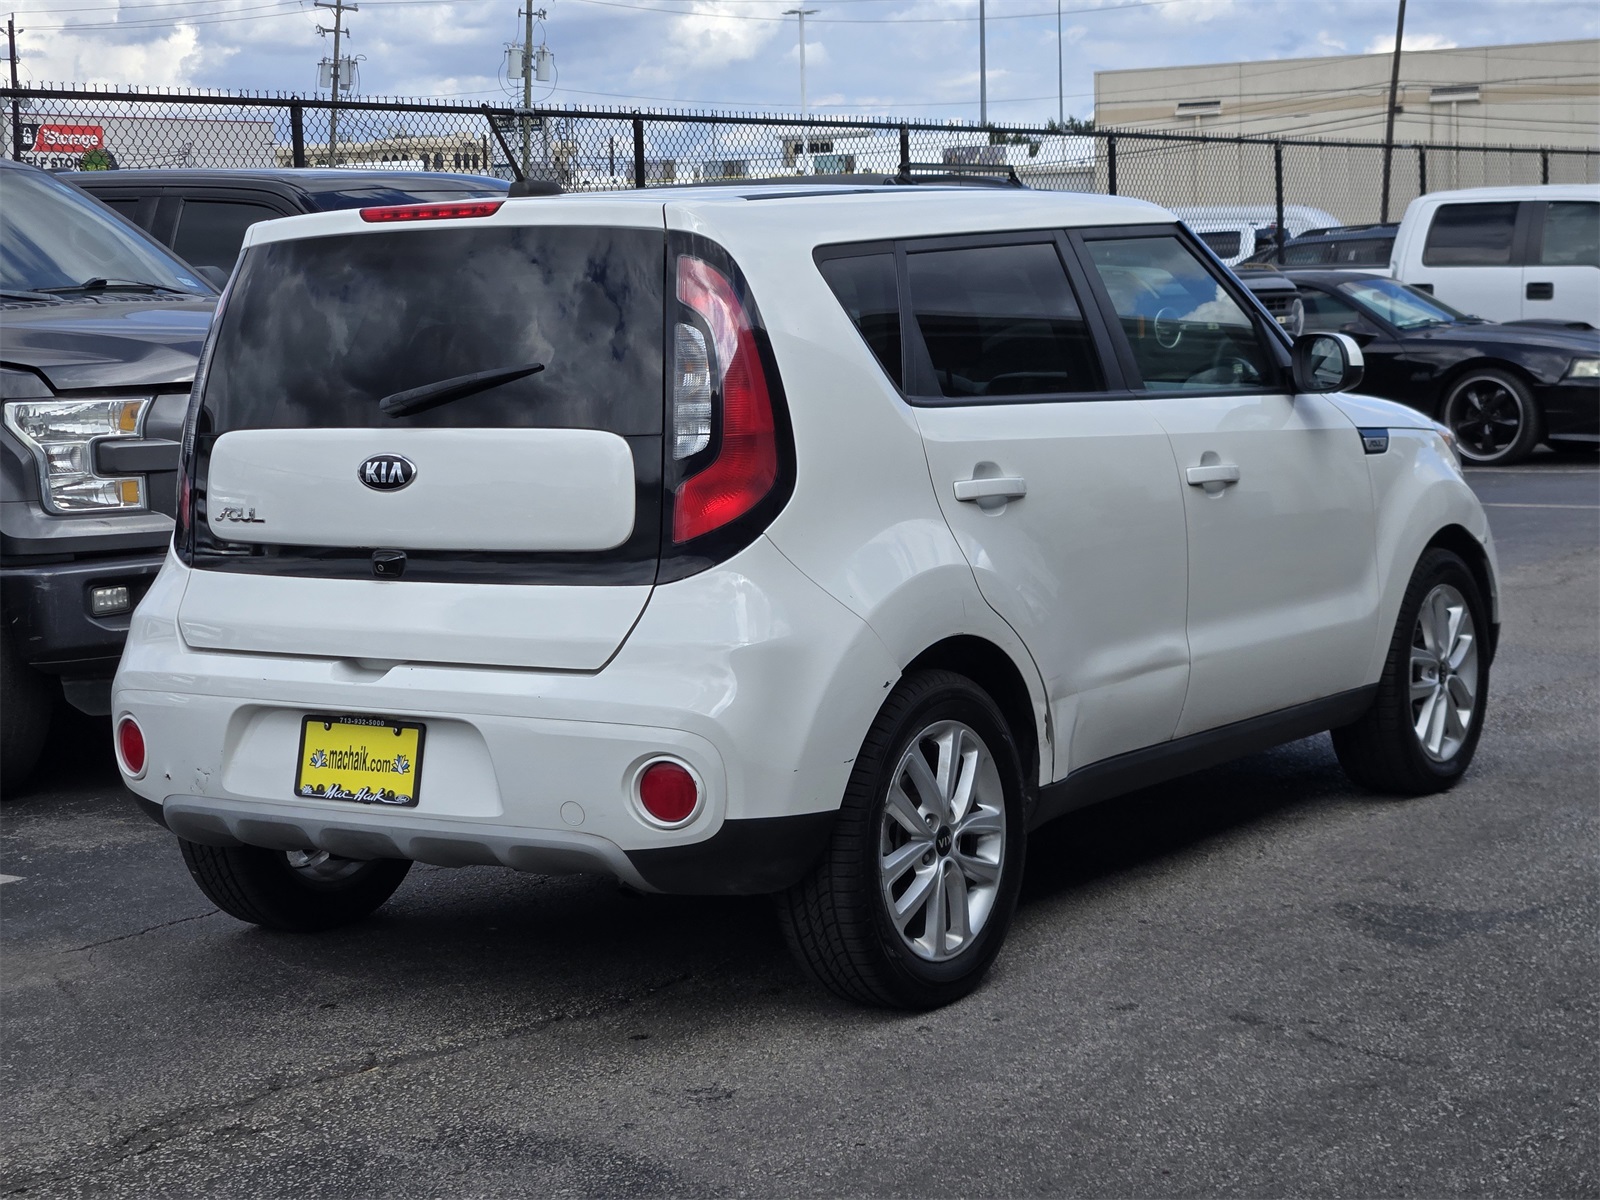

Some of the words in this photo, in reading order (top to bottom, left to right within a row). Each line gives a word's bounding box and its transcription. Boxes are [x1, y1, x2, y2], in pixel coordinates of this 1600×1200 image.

[43, 128, 99, 149] iStorage
[20, 157, 47, 171] ELF
[365, 461, 405, 483] KIA
[215, 507, 266, 523] SOUL
[340, 717, 385, 727] 713-932-5000
[327, 745, 391, 773] machaik.com
[323, 784, 353, 800] Mac
[353, 787, 385, 803] Haik
